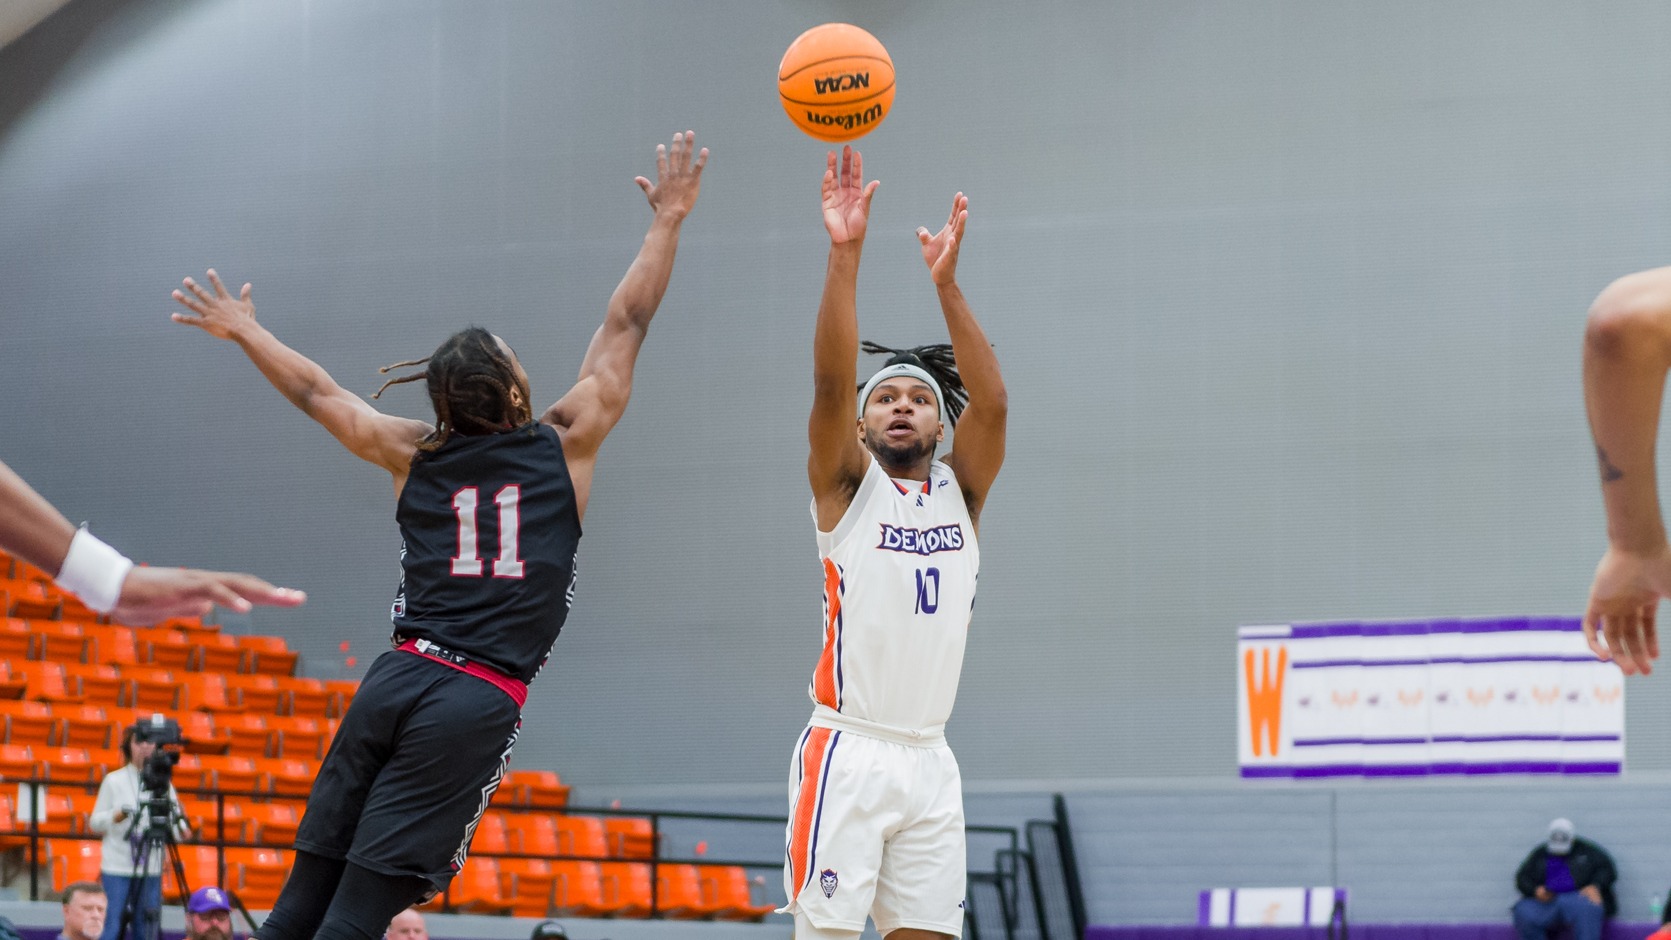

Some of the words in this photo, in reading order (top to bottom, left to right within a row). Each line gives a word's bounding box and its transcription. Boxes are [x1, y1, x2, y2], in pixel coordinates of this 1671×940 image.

[814, 72, 870, 95] NCAA
[806, 103, 883, 130] Wilson
[450, 483, 526, 579] 11
[882, 525, 963, 554] DEMONS
[914, 567, 940, 615] 10
[1245, 645, 1288, 757] W
